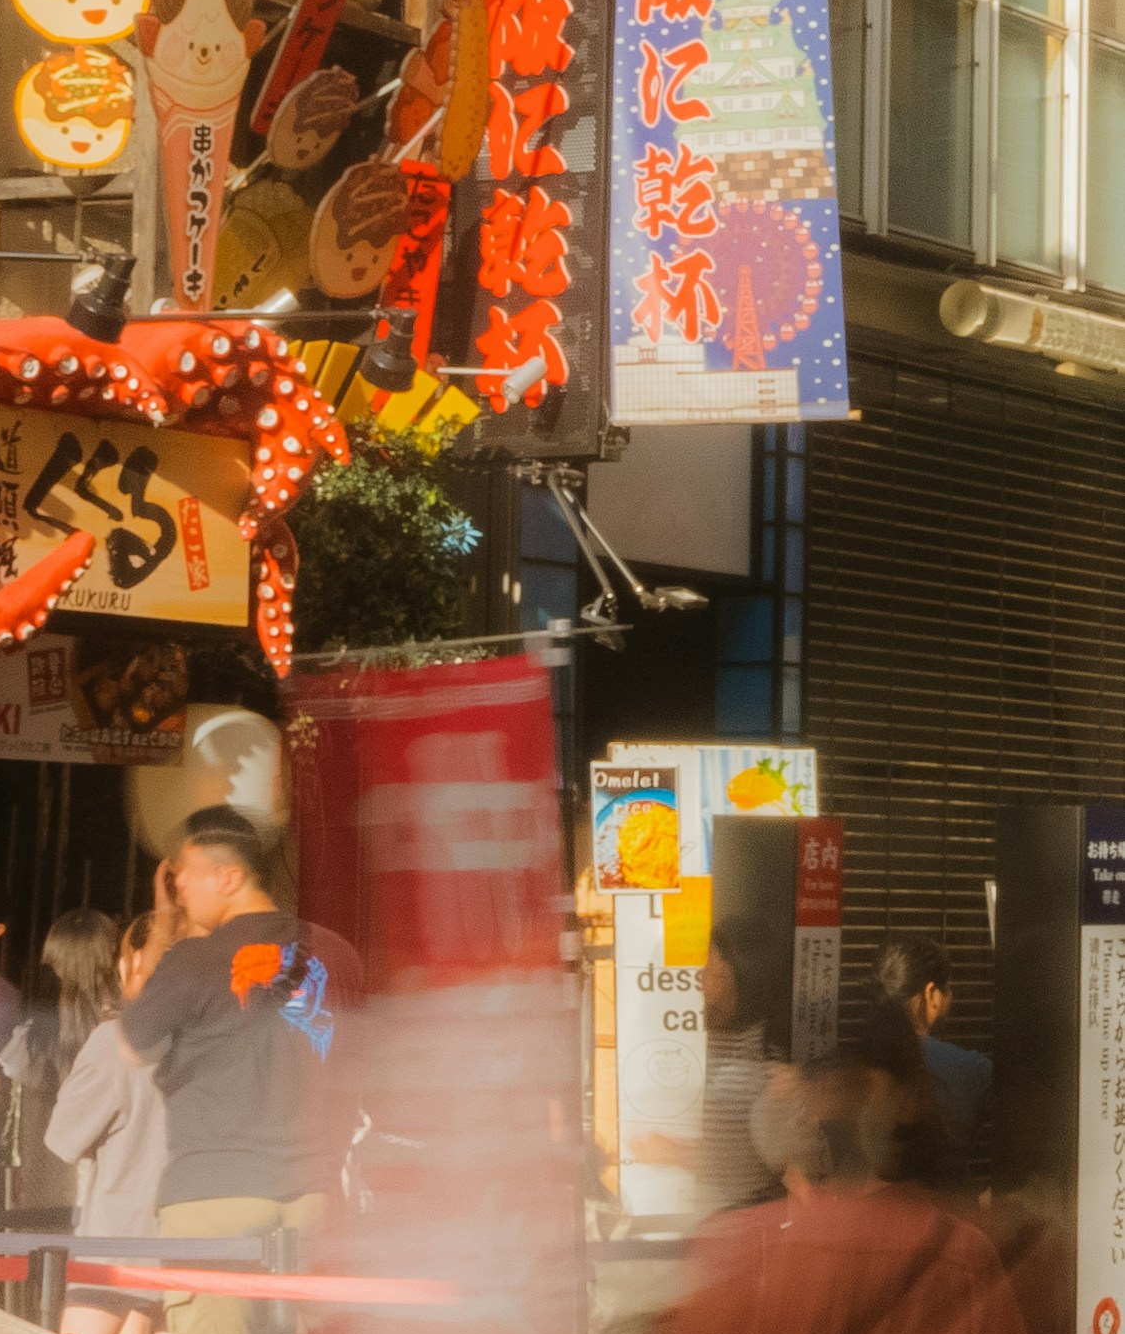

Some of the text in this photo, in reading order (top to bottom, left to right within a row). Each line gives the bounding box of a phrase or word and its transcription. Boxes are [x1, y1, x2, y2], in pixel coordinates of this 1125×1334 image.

[185, 122, 214, 302] 串かつケーキ
[22, 431, 176, 590] くくる
[594, 770, 660, 789] Omelet
